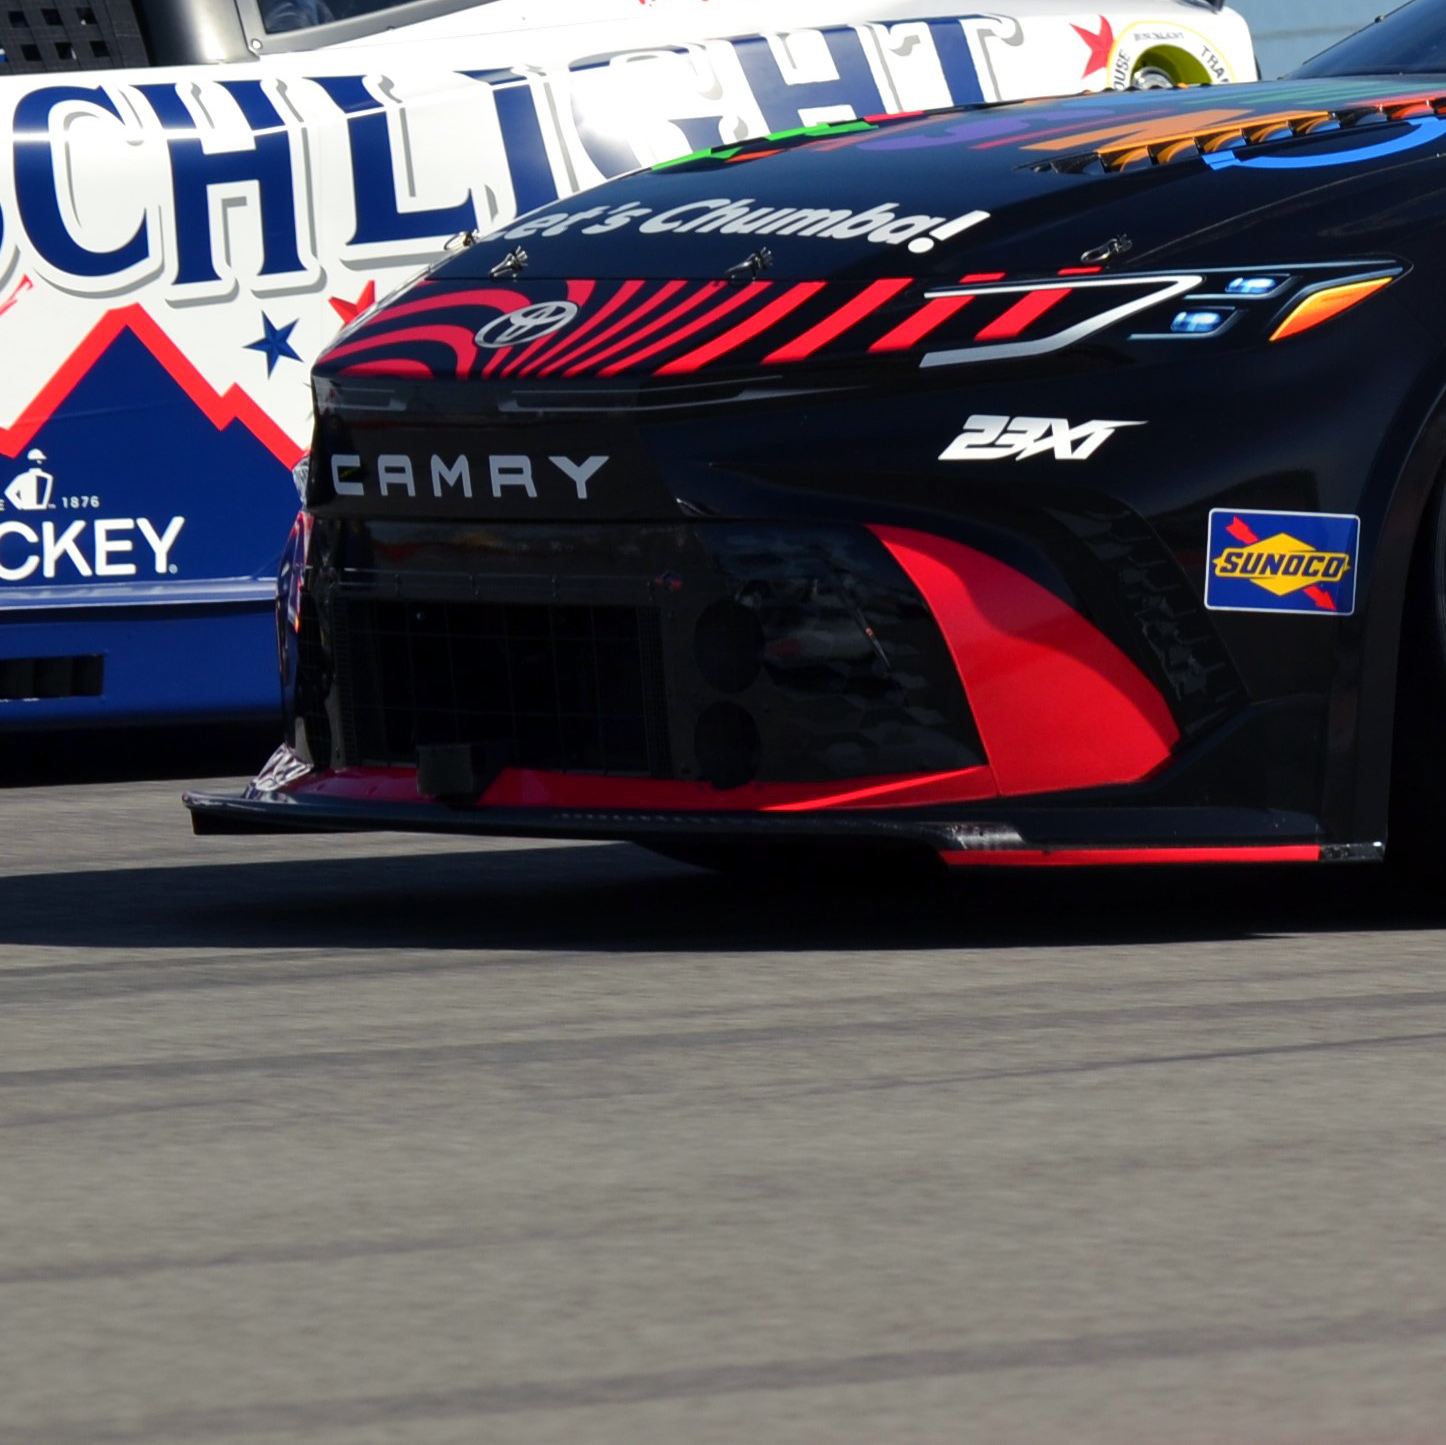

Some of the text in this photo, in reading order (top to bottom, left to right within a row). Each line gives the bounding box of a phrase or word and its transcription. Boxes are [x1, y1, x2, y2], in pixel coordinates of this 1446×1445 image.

[638, 198, 991, 254] Chumba!
[330, 454, 610, 499] CAMRY
[61, 494, 100, 509] 1876
[1220, 551, 1347, 580] SUNOCO
